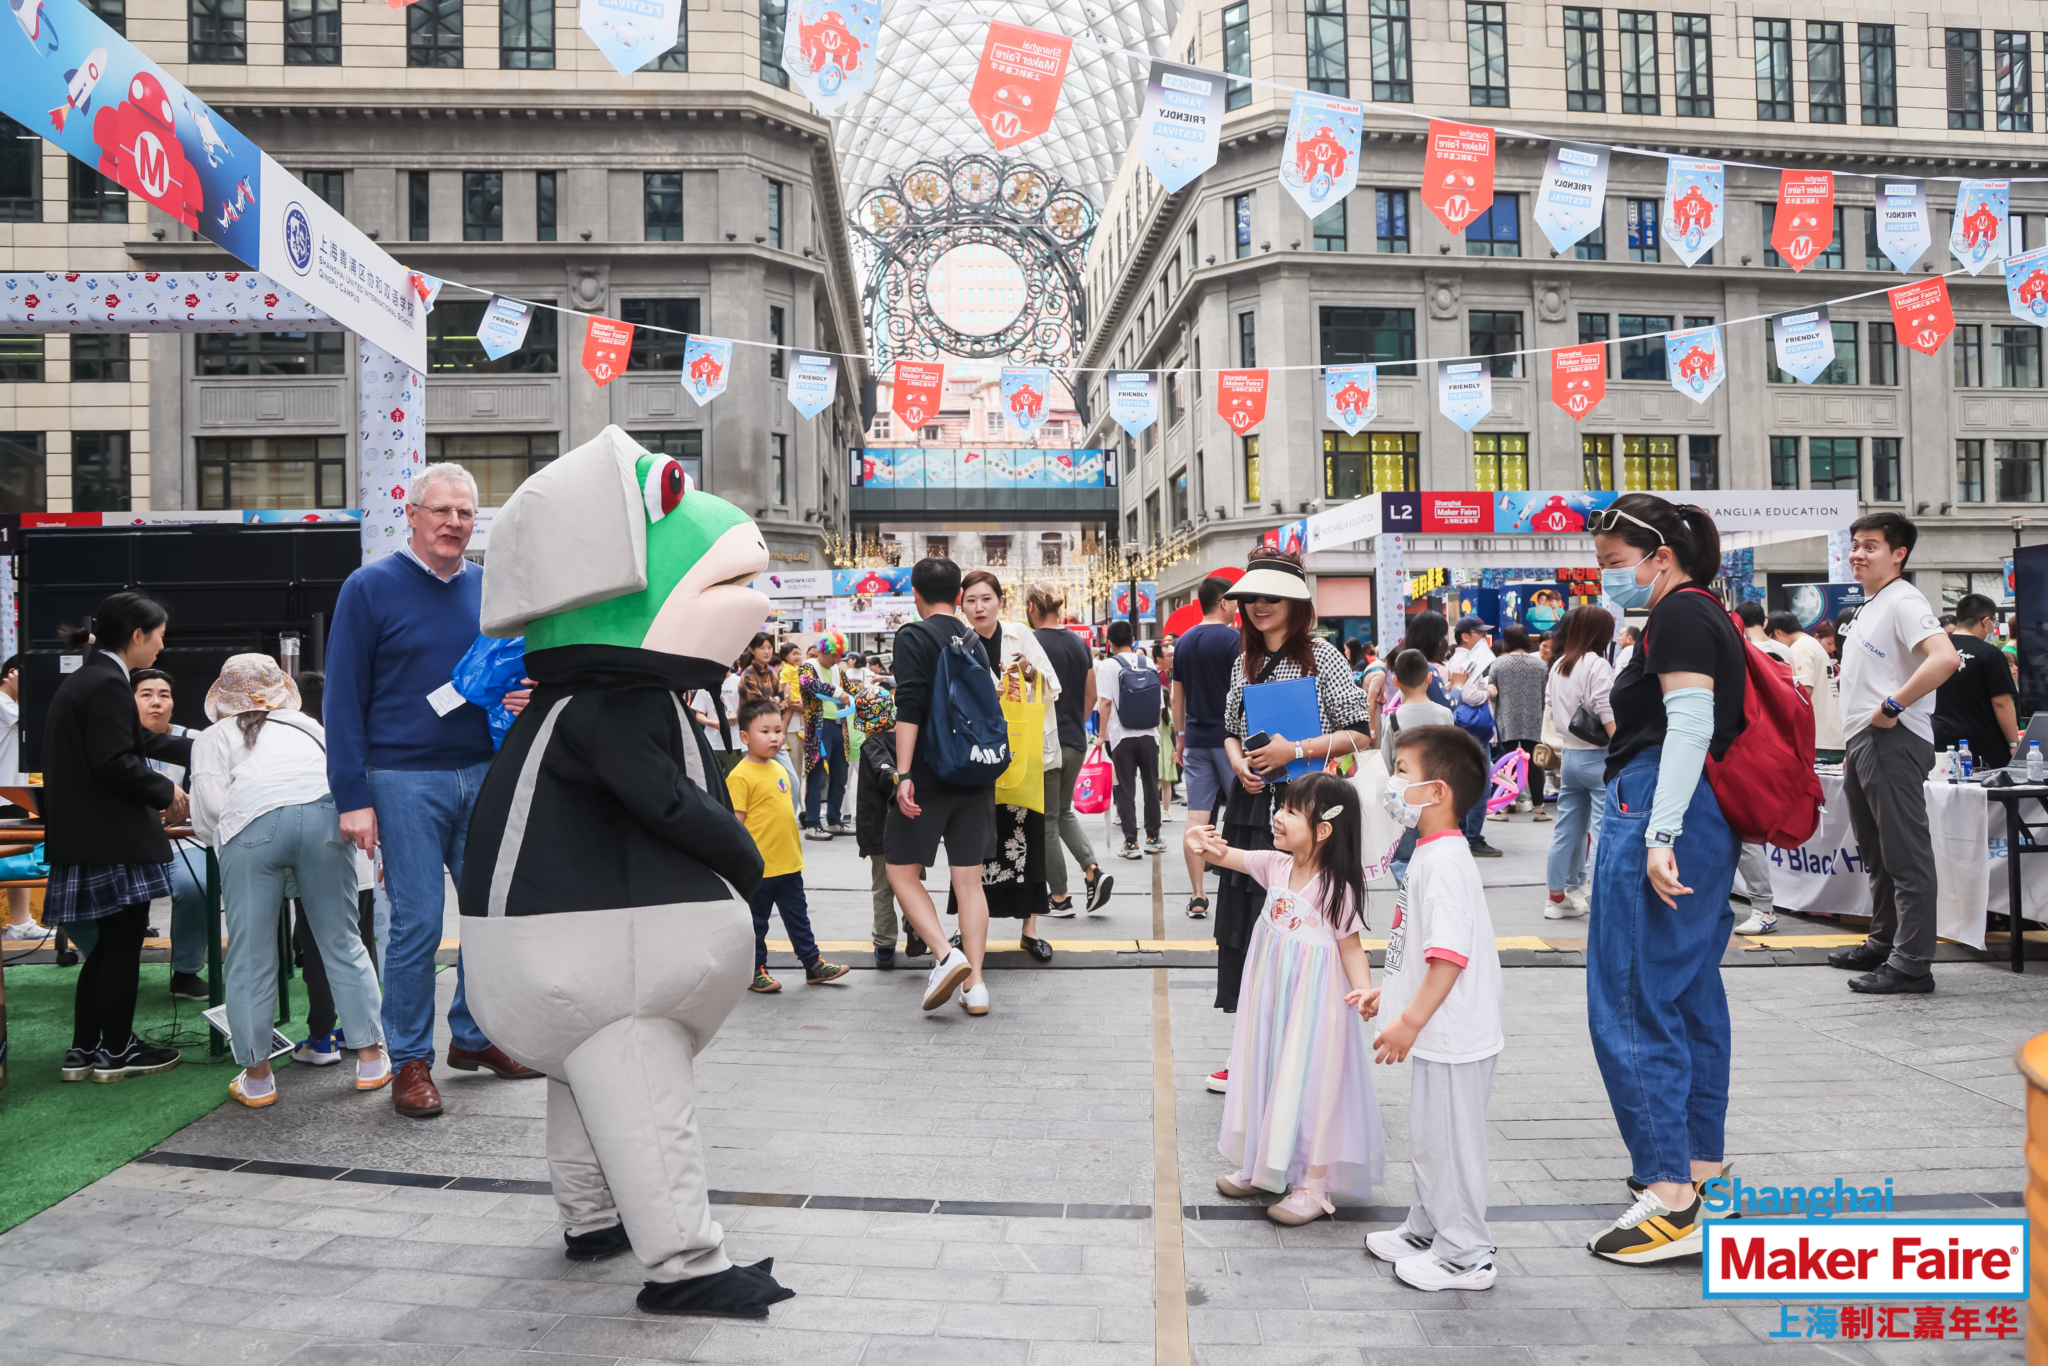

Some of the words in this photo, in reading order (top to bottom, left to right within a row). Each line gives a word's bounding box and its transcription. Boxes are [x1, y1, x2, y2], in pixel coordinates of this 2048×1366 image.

[140, 136, 164, 193] M
[319, 268, 338, 288] QINGPU
[339, 283, 360, 303] CAMPUS
[319, 255, 346, 281] SHANGHAI
[346, 274, 363, 293] UNITED
[364, 288, 396, 318] INTERNATIONAL
[2033, 280, 2042, 289] M
[1893, 287, 1920, 299] Shanghai
[1897, 295, 1920, 306] Maker
[1920, 290, 1938, 300] Faire
[498, 308, 520, 317] FAMILY
[492, 315, 519, 326] FRIENDLY
[1784, 313, 1816, 324] LARGEST
[490, 323, 517, 335] FESTIVAL
[594, 328, 611, 338] Maker
[612, 331, 627, 340] Faire
[1788, 324, 1814, 333] FAMILY
[1785, 333, 1820, 343] FRIENDLY
[1919, 331, 1935, 346] M
[1786, 343, 1823, 353] FESTIVAL
[1557, 350, 1582, 358] Shanghai
[702, 363, 709, 371] M
[1692, 357, 1701, 366] M
[598, 366, 609, 377] M
[901, 371, 920, 379] Maker
[798, 374, 827, 382] FRIENDLY
[797, 383, 827, 391] FESTIVAL
[1022, 395, 1029, 403] M
[1347, 392, 1356, 400] M
[1571, 396, 1585, 409] M
[909, 409, 921, 420] M
[1235, 413, 1246, 425] M
[1435, 499, 1461, 507] Shanghai
[1390, 505, 1412, 519] L2
[1437, 508, 1459, 516] Maker
[1460, 508, 1478, 516] Faire
[1715, 508, 1761, 517] ANGLIA
[1766, 507, 1839, 516] EDUCATION
[1349, 512, 1375, 528] EDUCATION
[1551, 515, 1563, 528] M
[0, 528, 8, 541] 1
[770, 553, 792, 563] rning
[793, 553, 810, 562] LAB
[1558, 568, 1600, 581] 斯坦星
